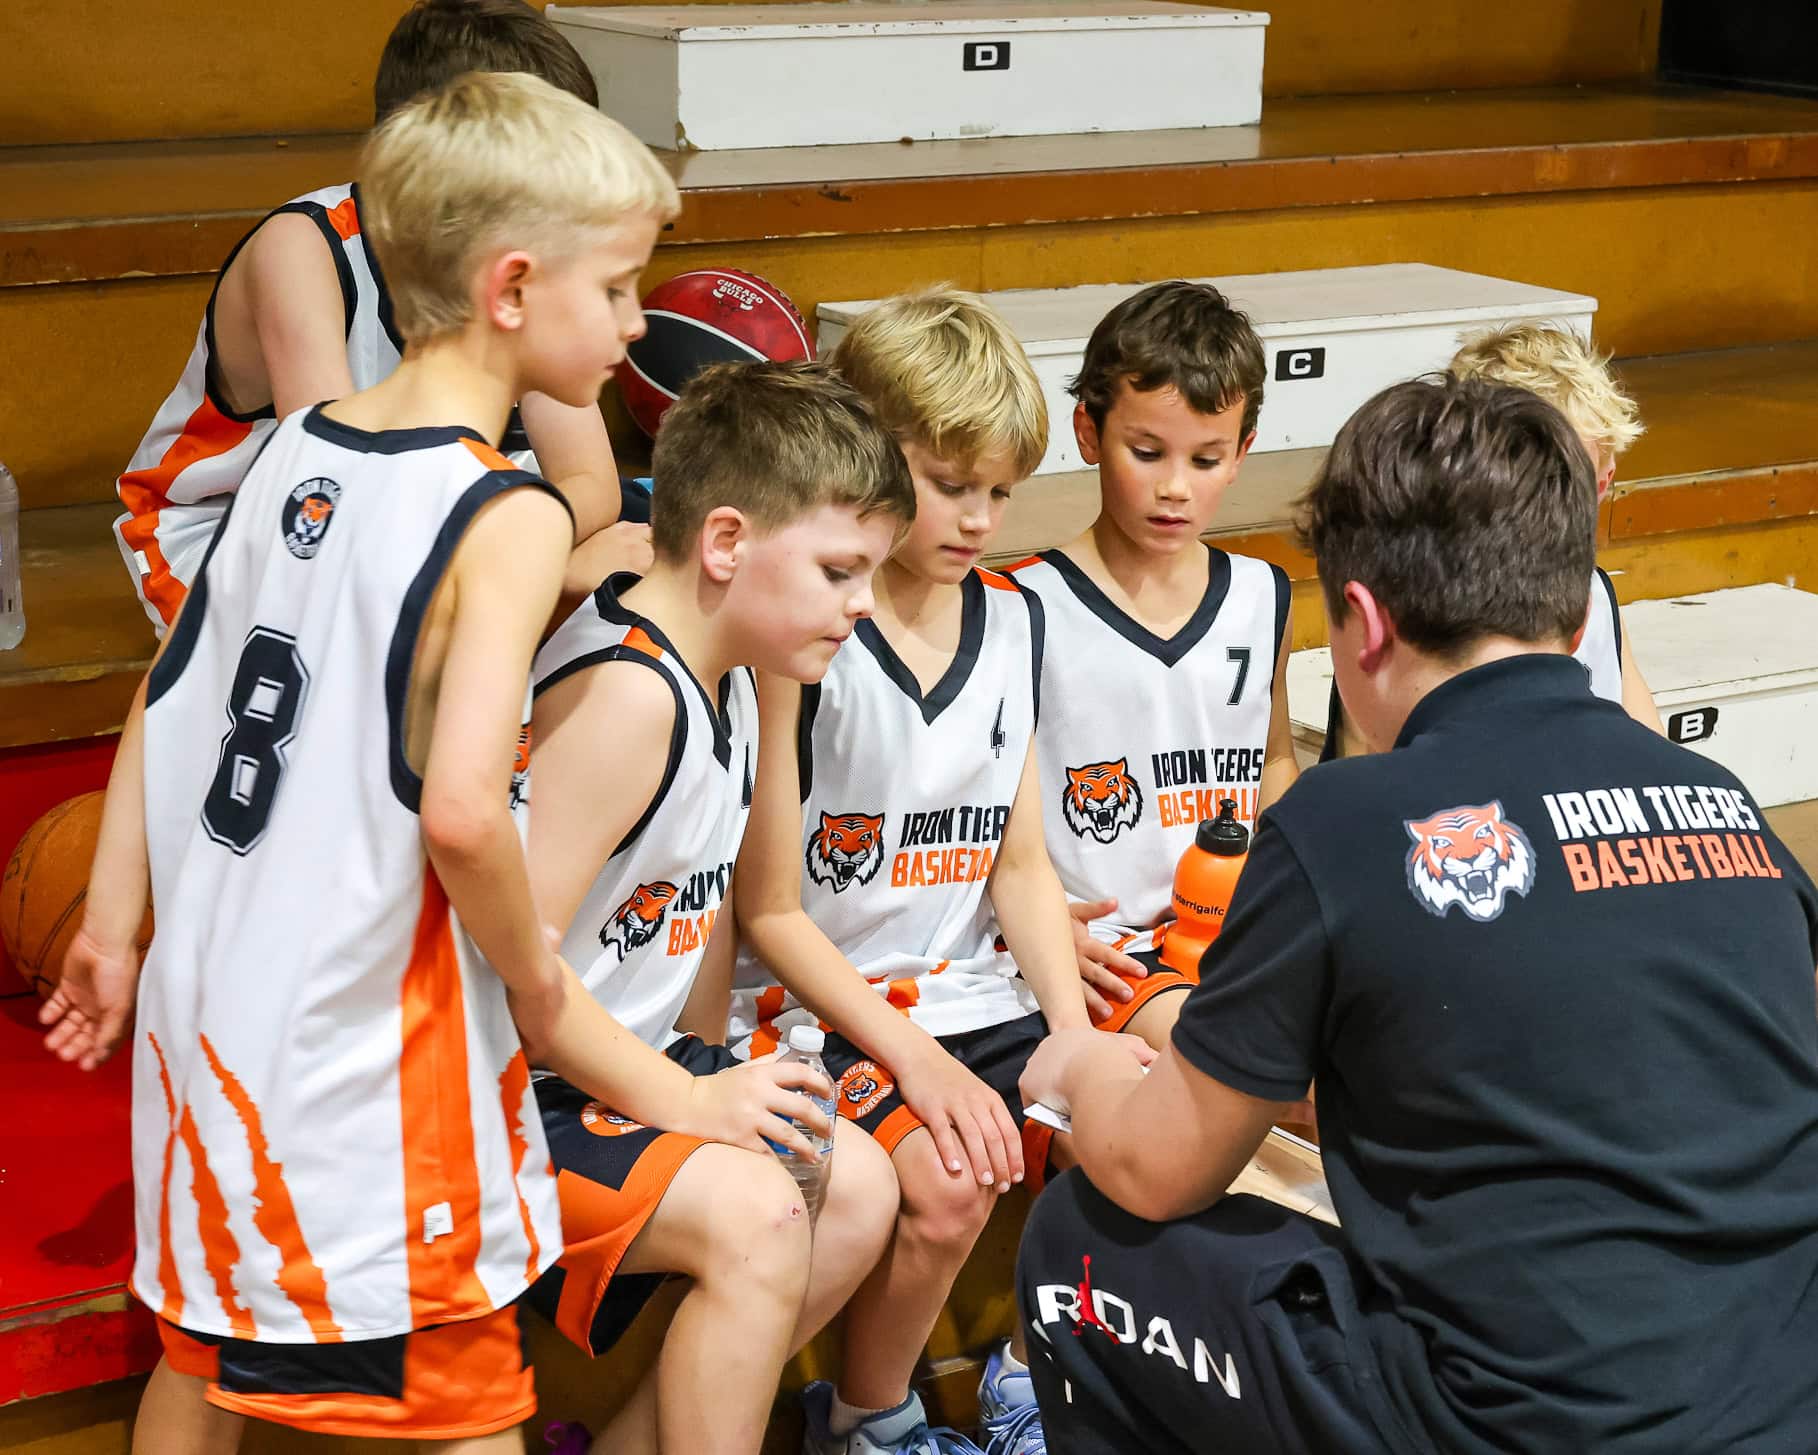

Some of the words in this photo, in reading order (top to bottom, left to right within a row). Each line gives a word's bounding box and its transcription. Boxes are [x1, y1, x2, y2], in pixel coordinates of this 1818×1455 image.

[975, 44, 999, 67] D
[716, 279, 764, 304] CHICAGO
[718, 285, 754, 305] BULLS
[1289, 352, 1312, 376] C
[1226, 646, 1252, 706] 7
[200, 624, 310, 857] 8
[1680, 712, 1705, 740] B
[1151, 748, 1207, 789] IRON
[1211, 747, 1264, 782] GERS
[899, 807, 955, 849] IRON
[958, 805, 1011, 843] TIER
[1542, 786, 1650, 841] IRON
[1642, 785, 1760, 831] TIGERS
[891, 847, 994, 888] BASKETA
[1561, 833, 1783, 892] BASKETBALL
[1032, 1284, 1242, 1403] RDAN
